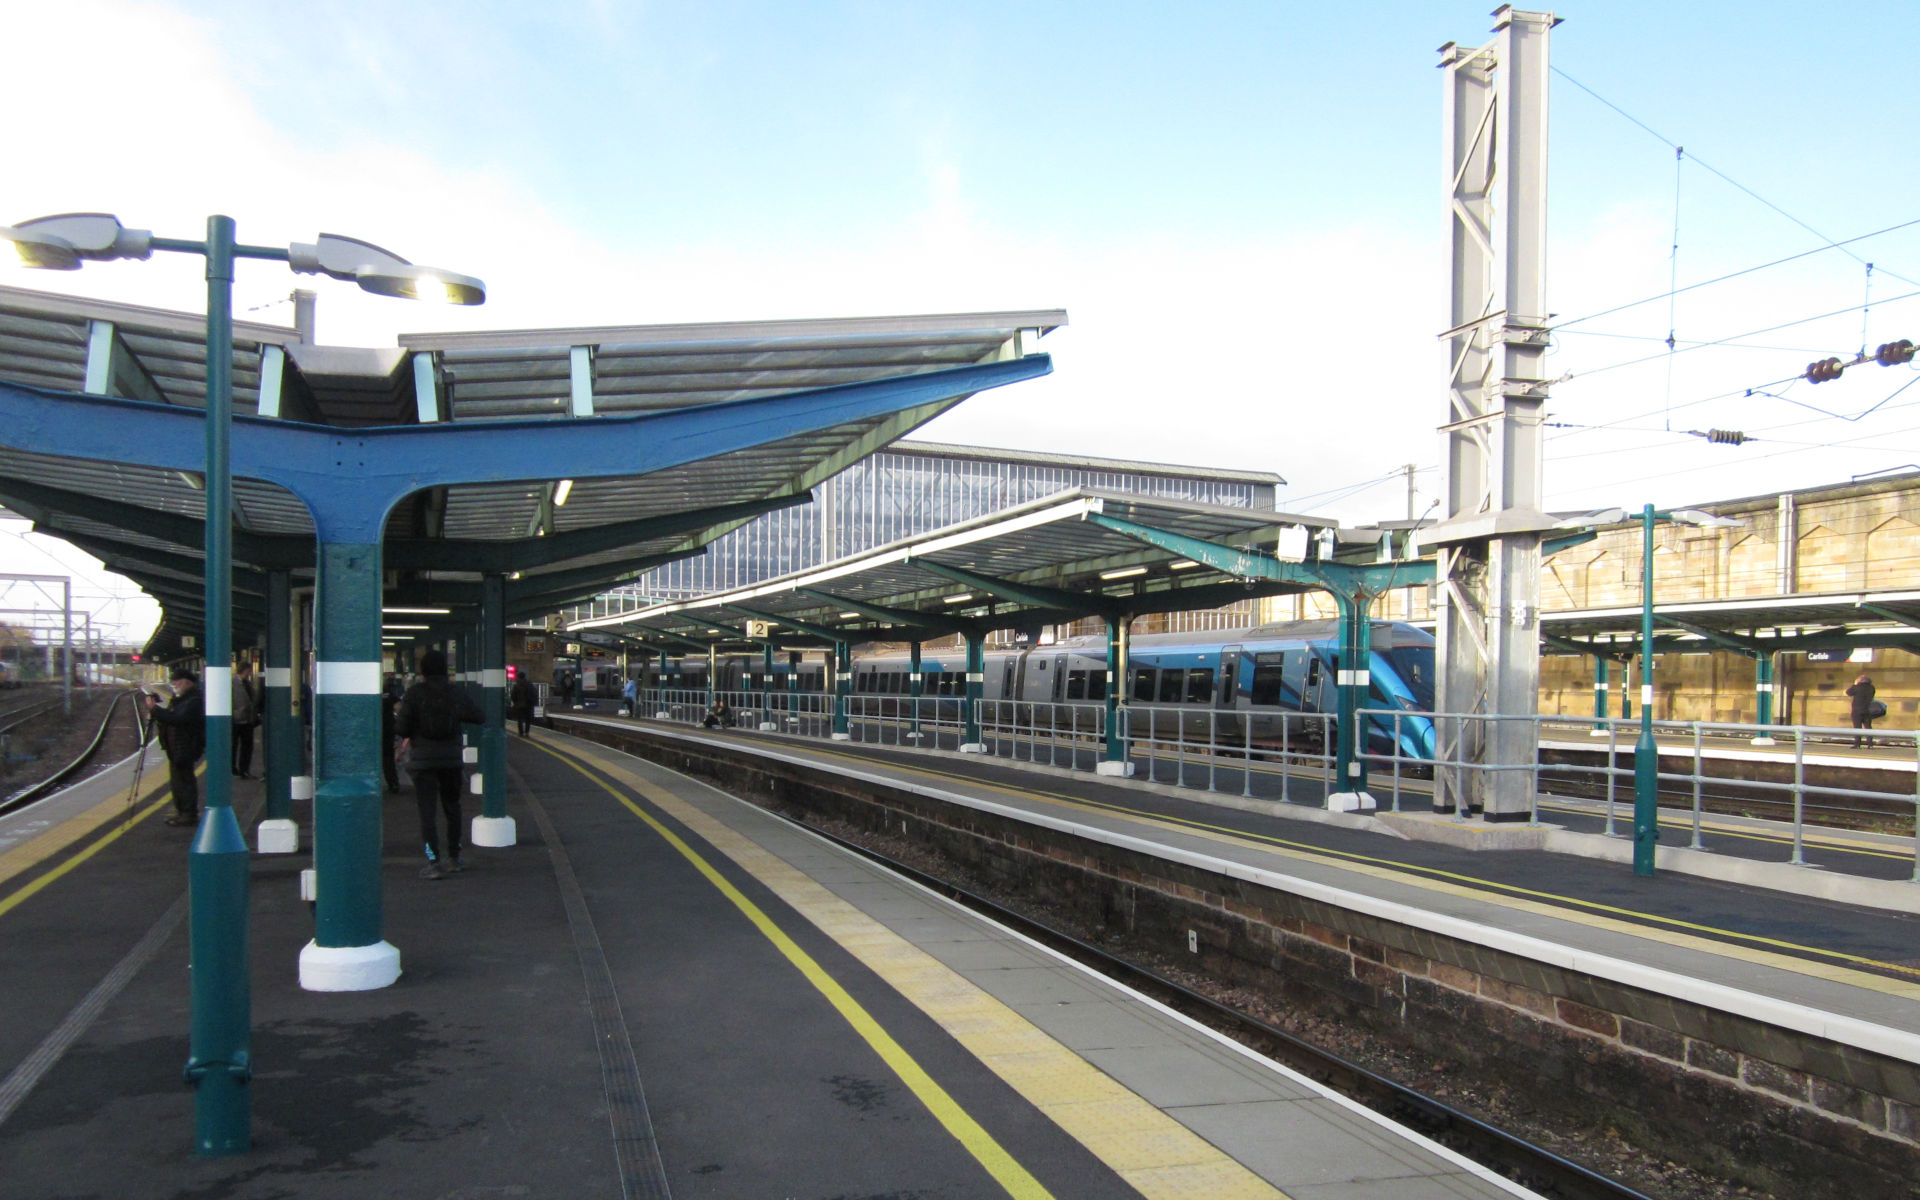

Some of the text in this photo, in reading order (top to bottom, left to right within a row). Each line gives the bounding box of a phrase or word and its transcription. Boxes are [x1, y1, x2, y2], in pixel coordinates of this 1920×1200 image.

[554, 616, 563, 629] 2
[755, 623, 764, 635] 2
[572, 645, 578, 653] 2
[1807, 652, 1829, 660] Carlisle
